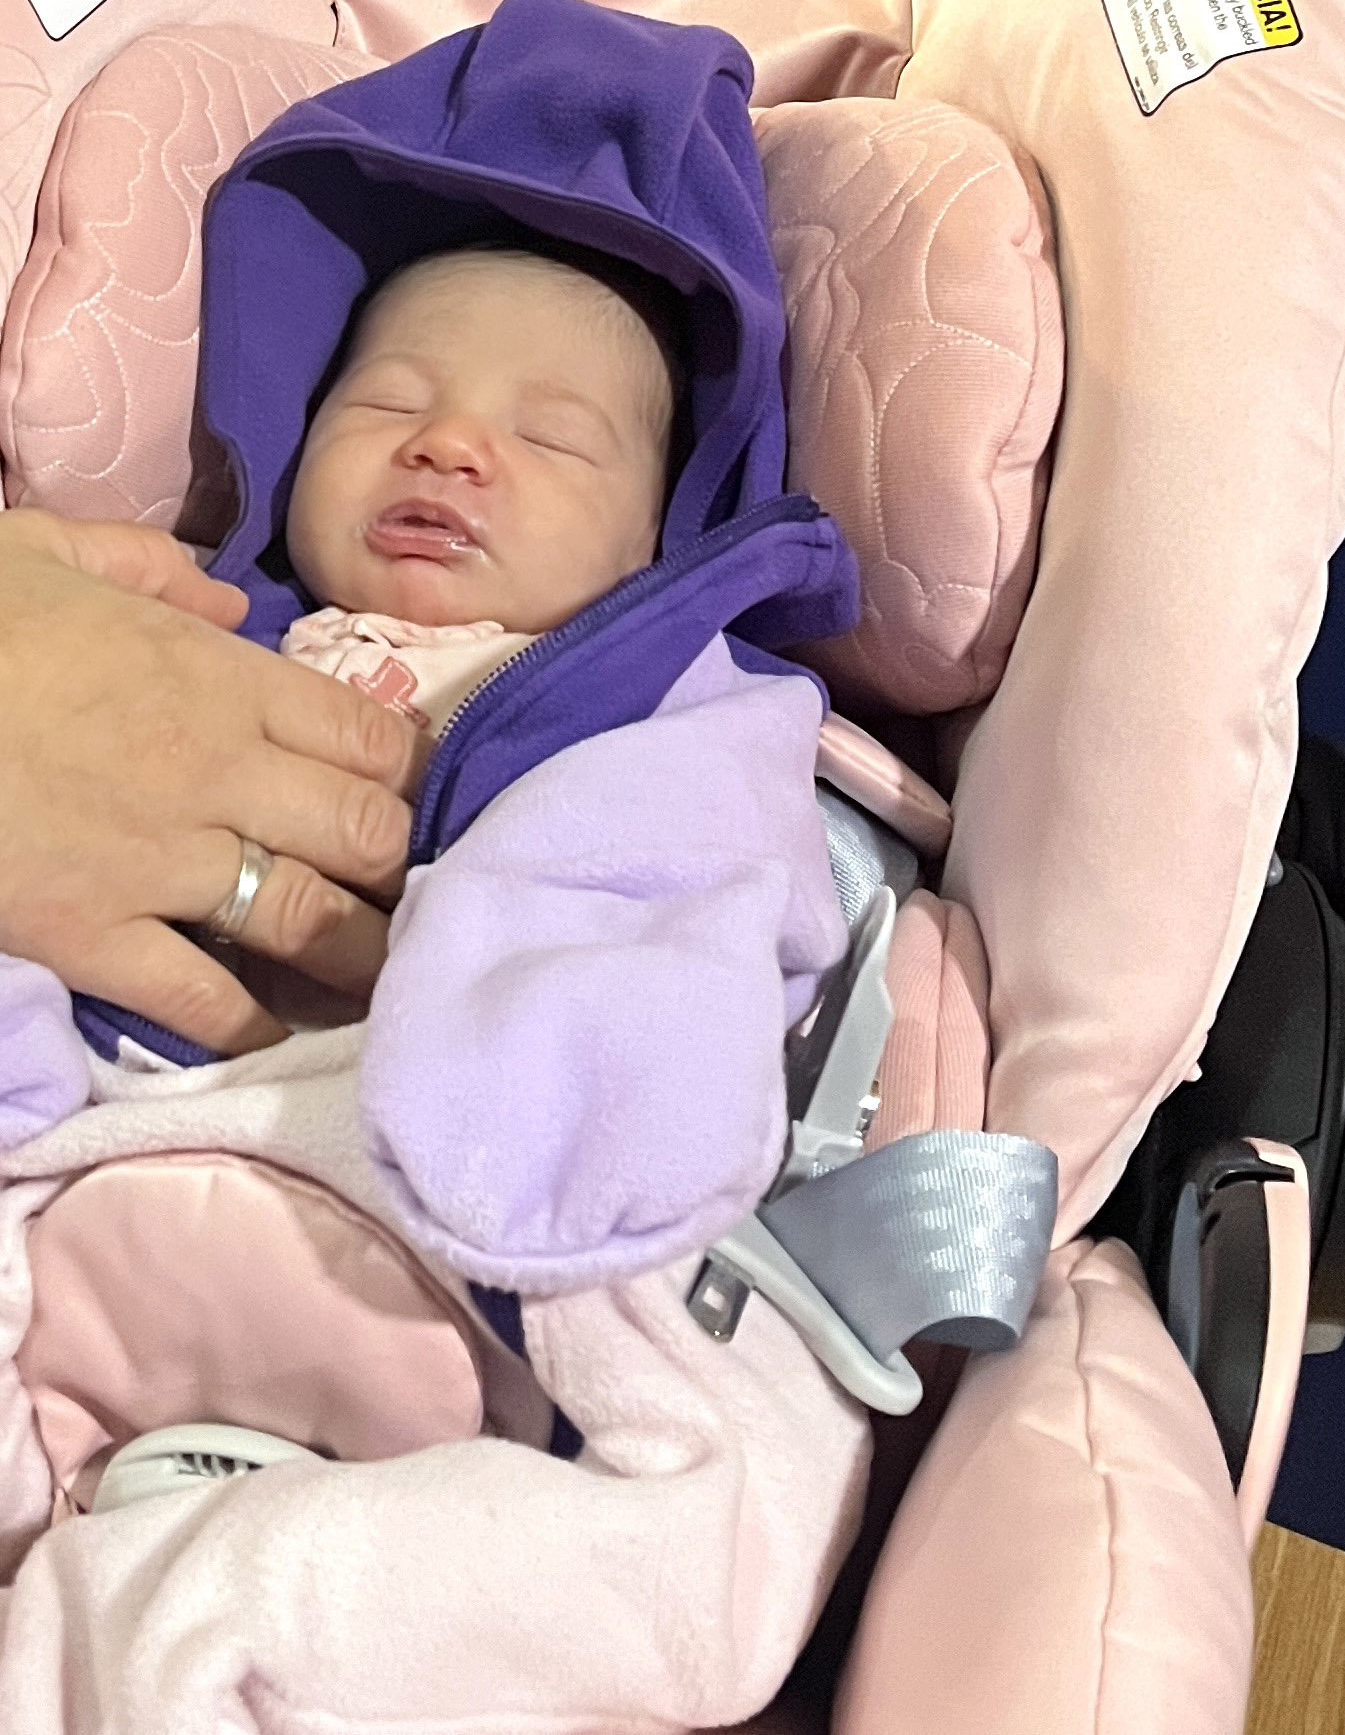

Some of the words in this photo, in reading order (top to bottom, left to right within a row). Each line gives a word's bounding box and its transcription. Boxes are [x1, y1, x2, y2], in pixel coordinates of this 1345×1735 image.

[1168, 15, 1187, 51] correas
[1214, 14, 1228, 30] the
[1232, 5, 1258, 45] buckled
